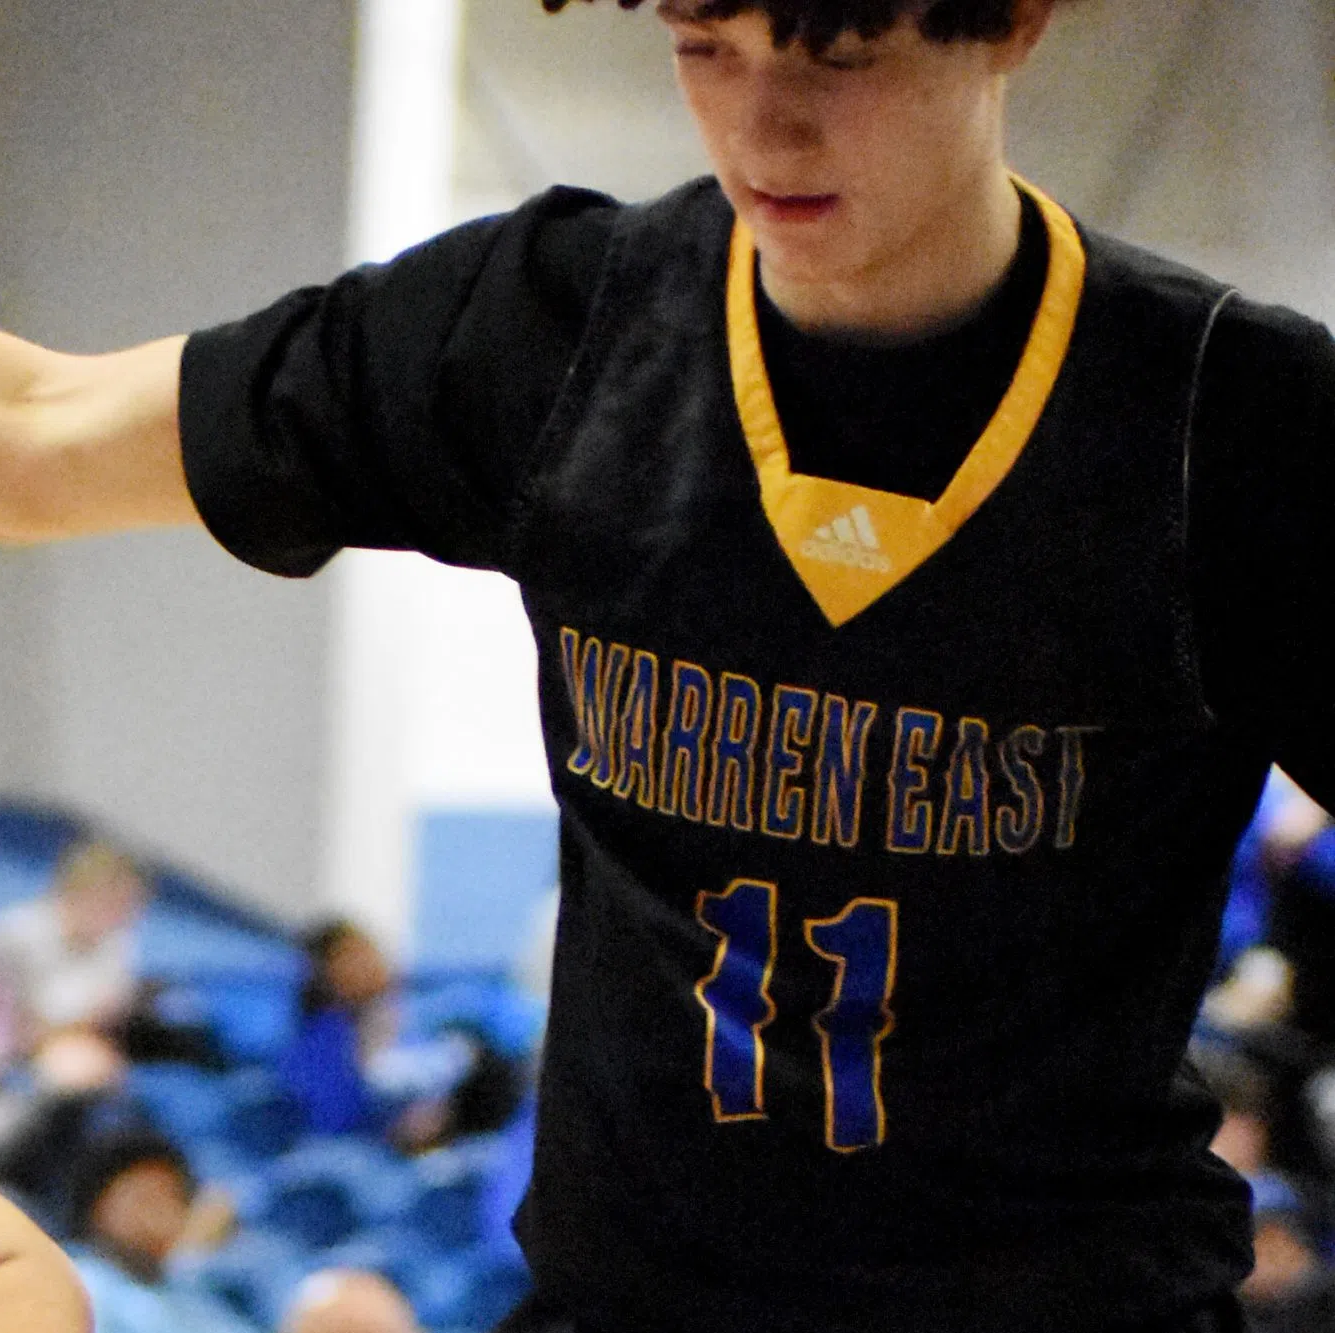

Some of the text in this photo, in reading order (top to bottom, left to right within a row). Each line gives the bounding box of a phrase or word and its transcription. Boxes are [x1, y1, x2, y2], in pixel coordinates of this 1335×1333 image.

[560, 626, 1106, 857] WARREN EAST
[695, 876, 898, 1154] 11
